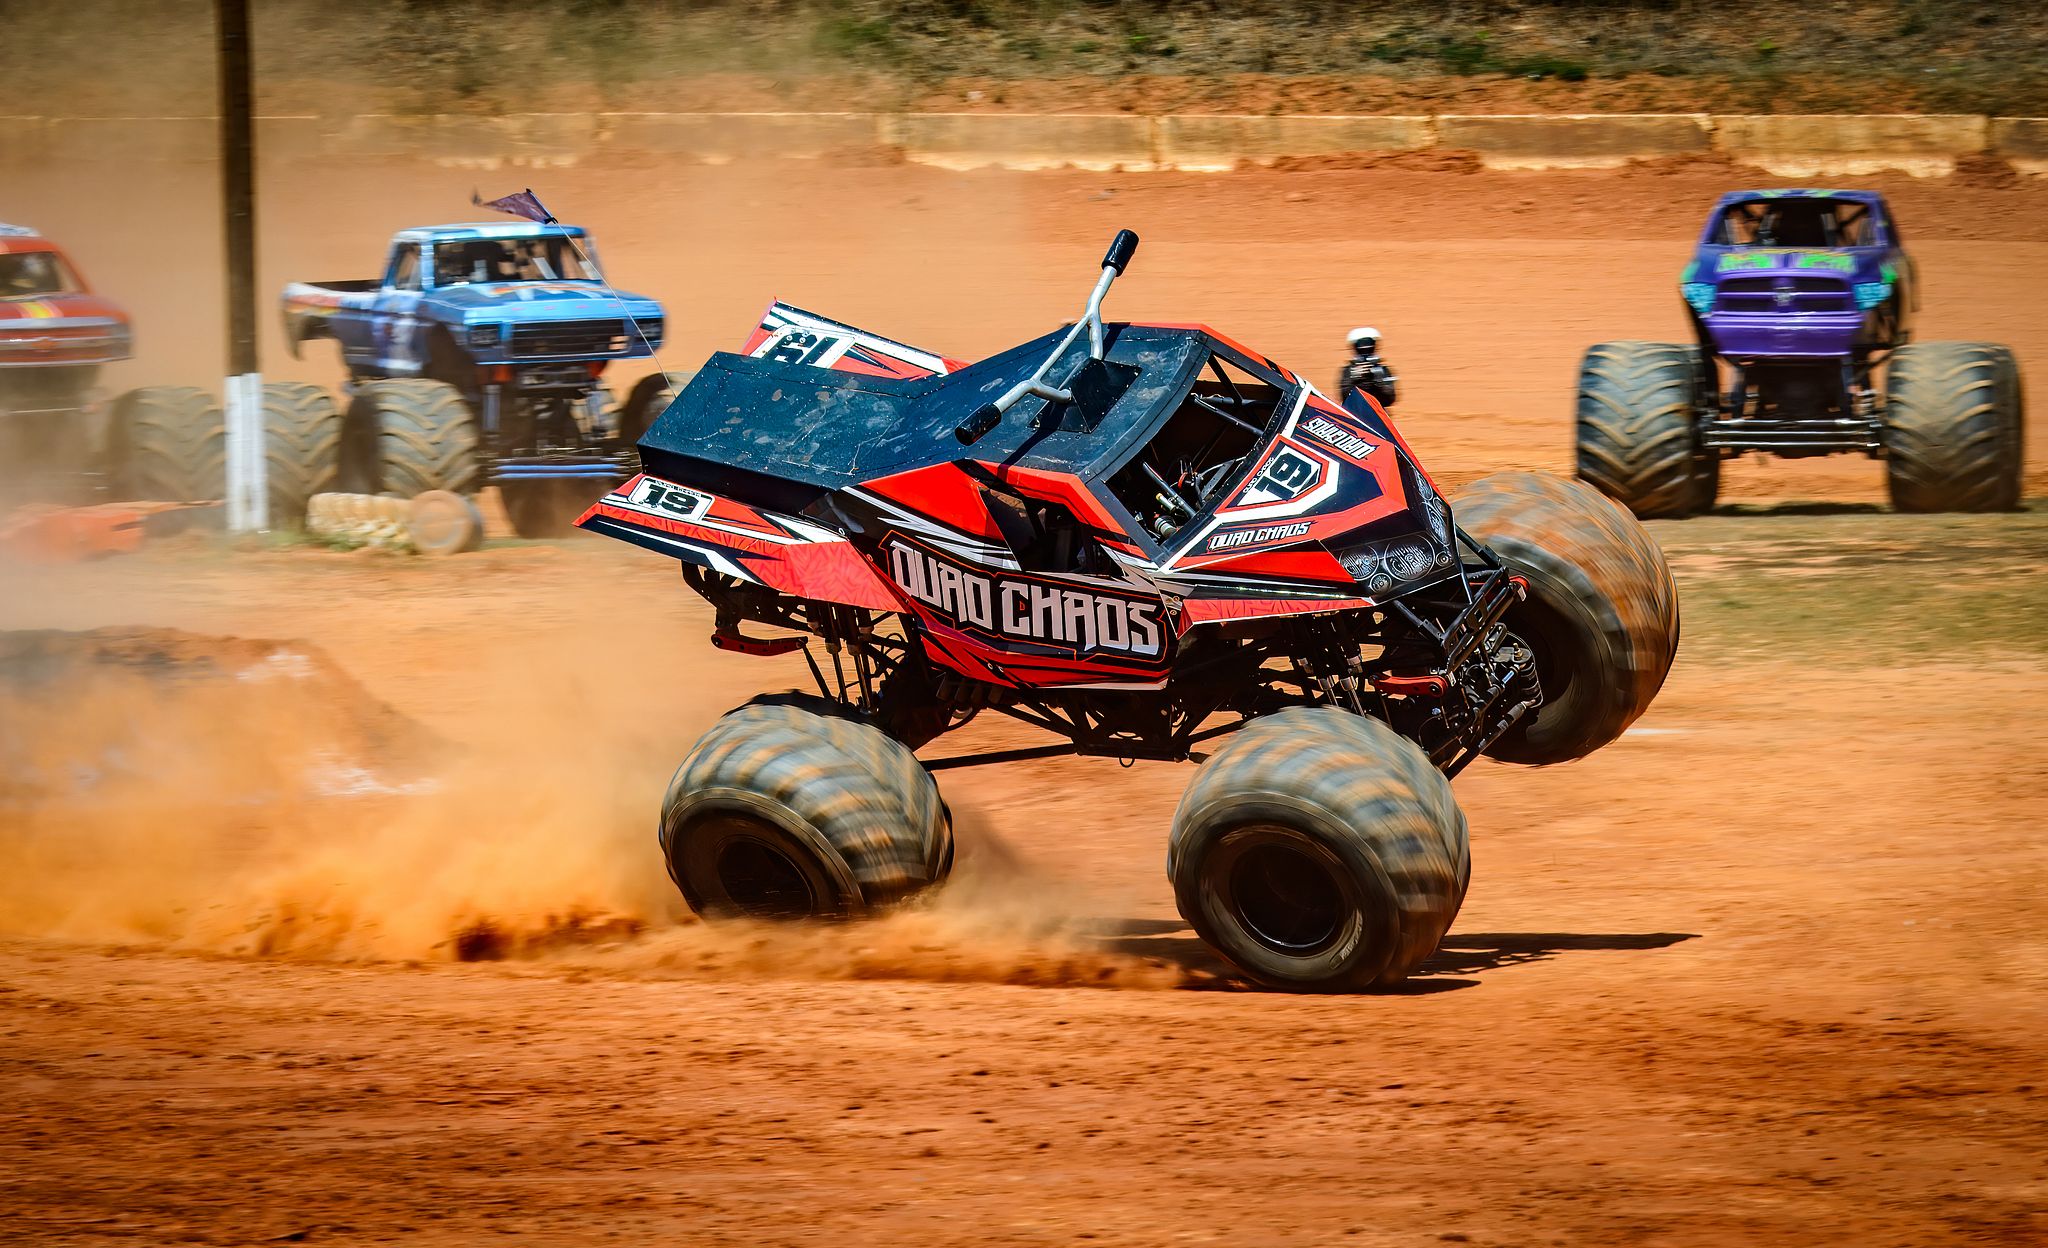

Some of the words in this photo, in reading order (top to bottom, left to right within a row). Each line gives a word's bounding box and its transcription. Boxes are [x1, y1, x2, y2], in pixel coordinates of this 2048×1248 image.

[1301, 417, 1351, 445] CHAOS
[1334, 434, 1377, 460] QUAD
[1254, 452, 1312, 501] 19
[644, 484, 699, 514] 19
[1208, 529, 1255, 551] QUAD
[1254, 521, 1312, 542] CHAOS
[889, 540, 994, 631] QUAD
[999, 580, 1164, 656] CHAOS
